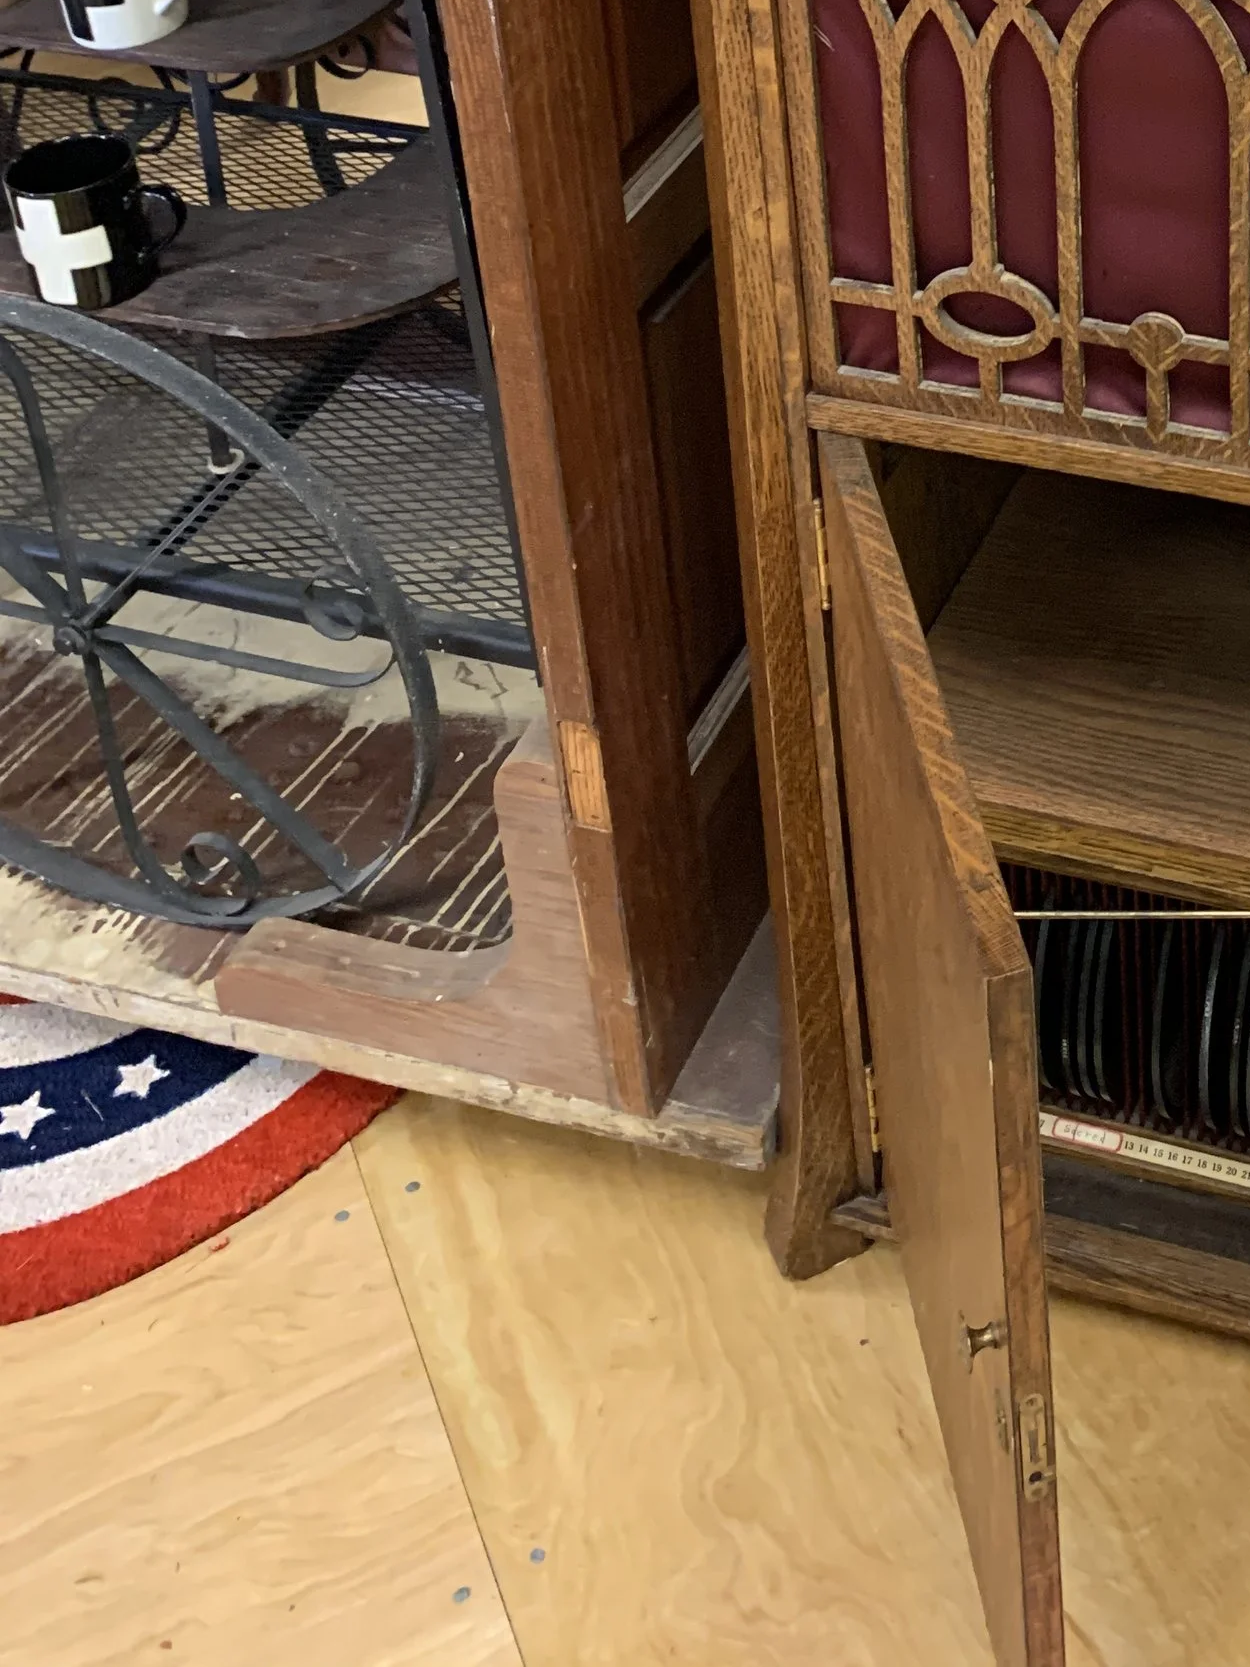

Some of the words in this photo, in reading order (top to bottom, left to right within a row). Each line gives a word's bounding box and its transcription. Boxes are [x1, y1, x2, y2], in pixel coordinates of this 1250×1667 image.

[1124, 1141, 1134, 1150] 13
[1138, 1144, 1149, 1154] 14
[1153, 1148, 1164, 1158] 15
[1167, 1151, 1179, 1161] 16
[1182, 1155, 1193, 1165] 17
[1197, 1159, 1208, 1169] 18
[1212, 1162, 1222, 1172] 19
[1226, 1166, 1237, 1176] 20
[1241, 1170, 1250, 1180] 21
